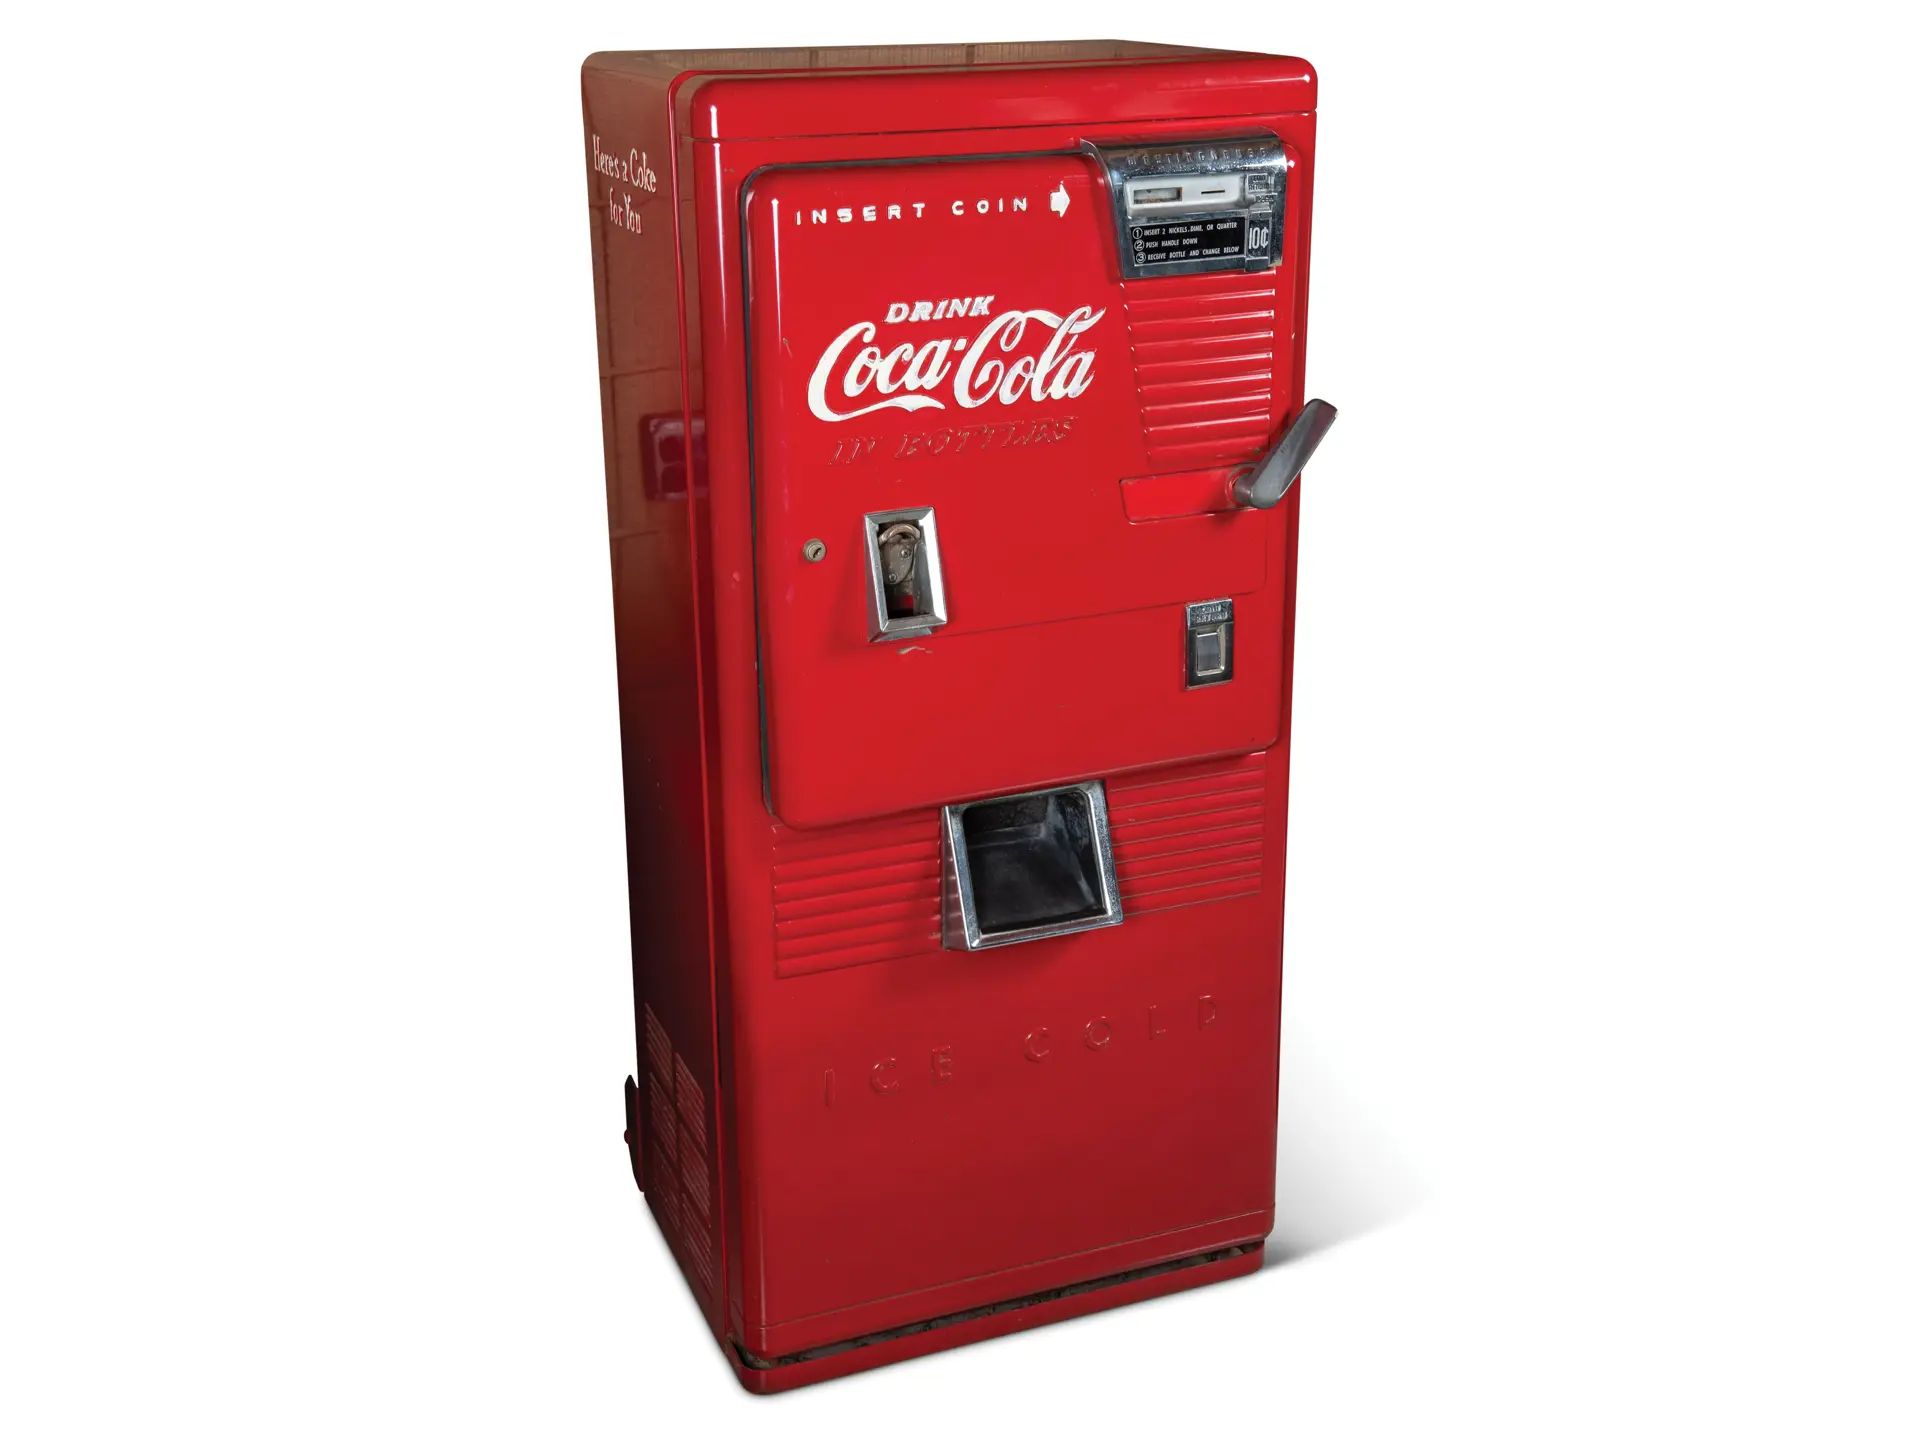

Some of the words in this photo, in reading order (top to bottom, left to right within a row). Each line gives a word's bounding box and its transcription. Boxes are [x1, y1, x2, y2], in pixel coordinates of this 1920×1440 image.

[592, 134, 620, 179] Here's
[622, 160, 628, 182] a
[630, 147, 657, 193] Coke
[609, 186, 623, 227] for
[623, 193, 642, 234] You
[796, 202, 925, 225] INSERT
[951, 197, 1027, 215] COIN
[1144, 228, 1160, 236] INSERT
[1217, 221, 1237, 230] QUARTER
[1248, 226, 1269, 249] 10¢
[1145, 241, 1158, 249] PUSH
[1161, 239, 1179, 247] HANDLE
[1182, 237, 1198, 245] DOWN
[1147, 252, 1166, 261] RECEIVE
[1169, 250, 1186, 259] BOTTLE
[1189, 249, 1199, 257] AND
[1202, 247, 1220, 255] CHANGE
[885, 295, 994, 323] DRINK
[808, 306, 1106, 422] Coca-Cola
[827, 436, 884, 465] IN
[824, 1045, 954, 1107] ICE
[1023, 994, 1217, 1064] COLD
